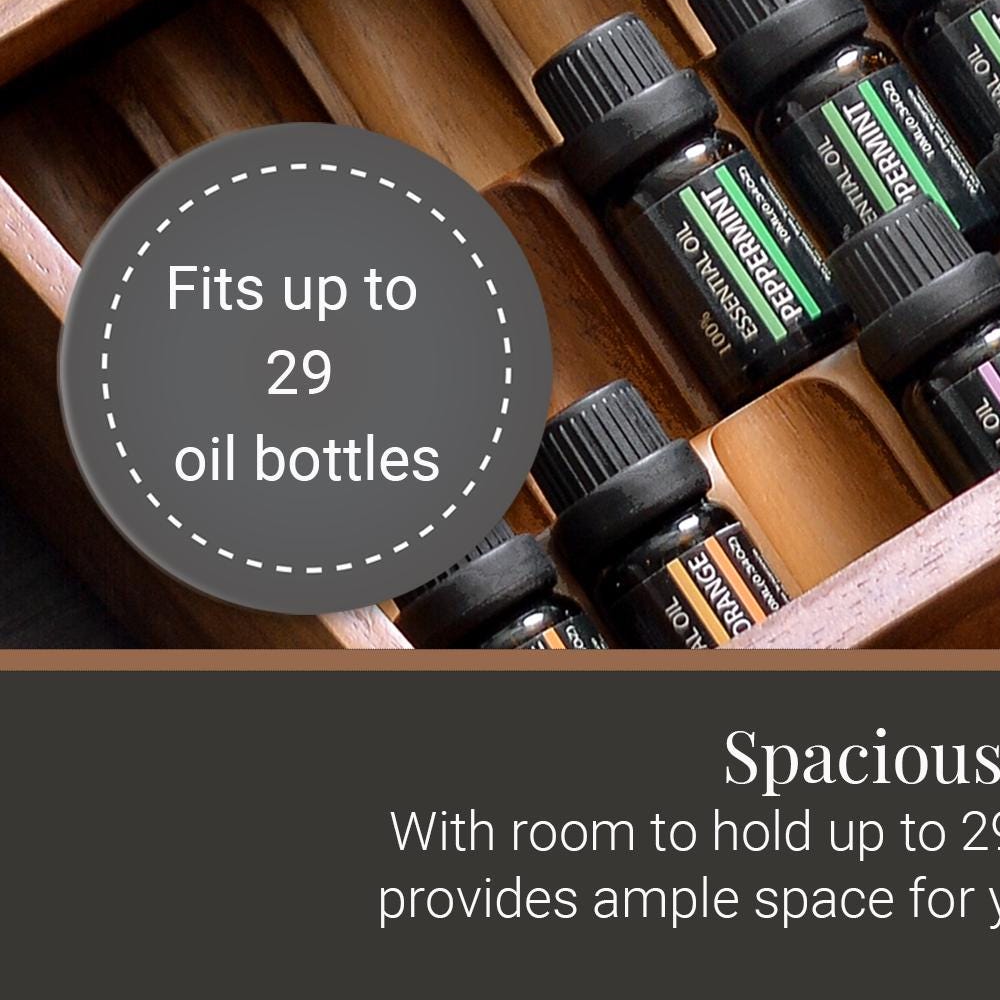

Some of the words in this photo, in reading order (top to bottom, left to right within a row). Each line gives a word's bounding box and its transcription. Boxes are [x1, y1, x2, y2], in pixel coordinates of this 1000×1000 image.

[967, 44, 992, 75] OIL
[817, 136, 842, 167] OIL
[842, 101, 917, 203] PERMINT
[836, 165, 878, 226] ENTIAL
[675, 221, 701, 254] OIL
[701, 187, 804, 322] PEPPERMINT
[696, 254, 759, 342] ESSENTIAL
[699, 310, 733, 356] 100%
[974, 396, 1000, 429] OIL
[687, 551, 752, 637] ORANGE
[728, 536, 780, 611] 0ML(0.34OZ)
[664, 596, 691, 631] OIL
